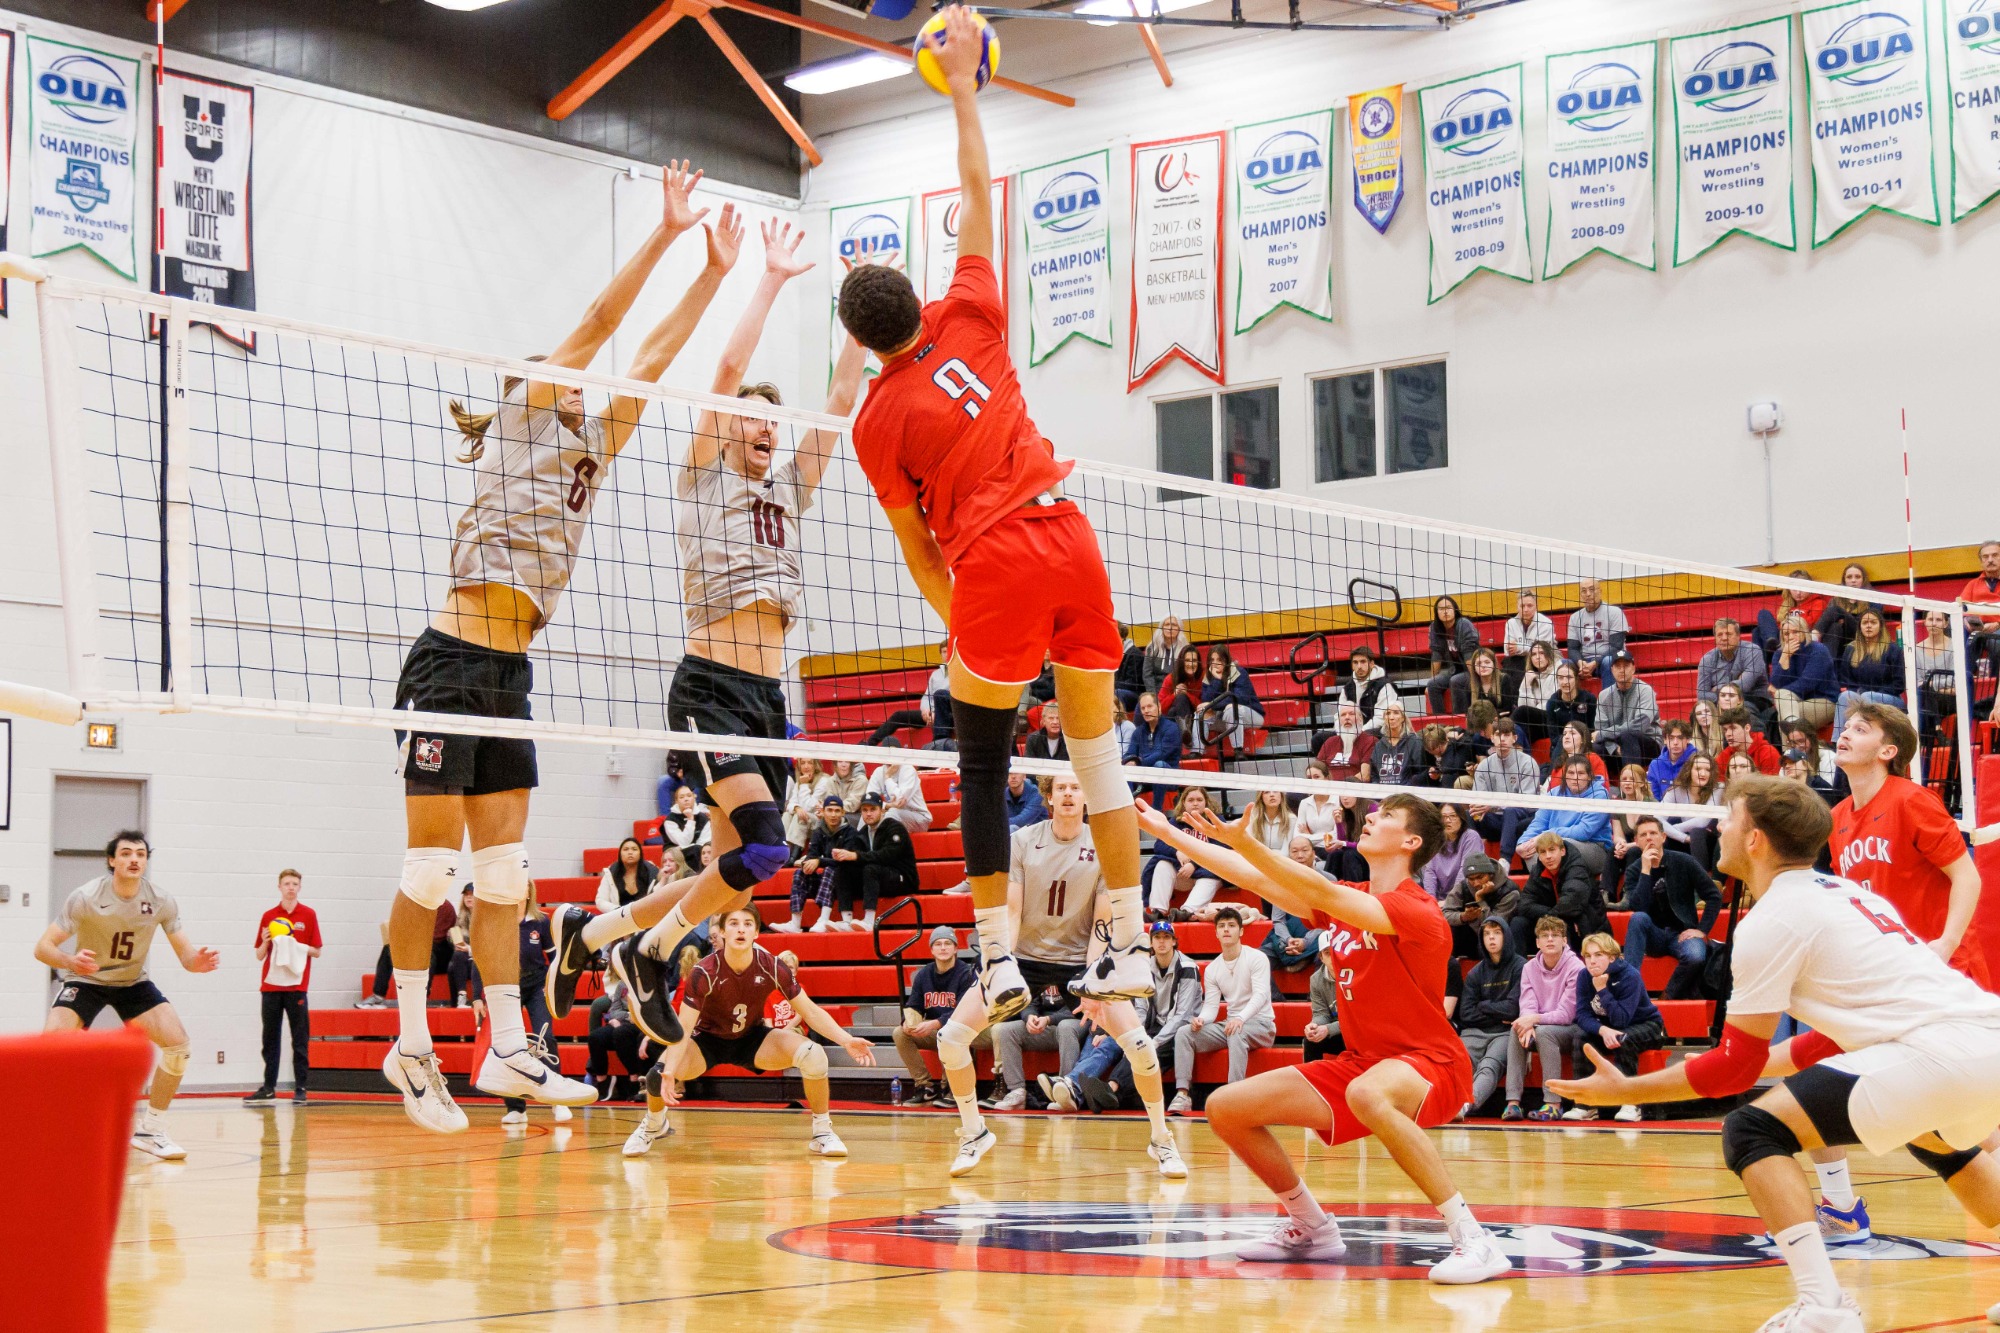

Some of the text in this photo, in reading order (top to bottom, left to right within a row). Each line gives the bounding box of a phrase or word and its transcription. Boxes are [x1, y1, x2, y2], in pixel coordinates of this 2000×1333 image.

[1818, 32, 1914, 72] OUA
[1684, 62, 1777, 97] OUA
[38, 72, 127, 110] OUA
[1557, 84, 1642, 114] OUA
[1955, 86, 2000, 108] CHA
[184, 121, 224, 140] SPORTS
[1432, 107, 1513, 143] OUA
[1816, 102, 1923, 139] CHAMPIONS
[40, 134, 130, 166] CHAMPIONS
[1684, 130, 1785, 162] CHAMPIONS
[1840, 136, 1898, 154] Women's
[1246, 150, 1322, 180] OUA
[1549, 151, 1648, 178] CHAMPIONS
[1704, 162, 1760, 178] Women's
[1838, 150, 1902, 169] Wrestling
[193, 166, 214, 184] MEN'S
[1702, 176, 1764, 192] Wrestling
[174, 180, 234, 216] WRESTLING
[1430, 170, 1520, 206] CHAMPIONS
[1580, 184, 1615, 194] Men's
[1842, 178, 1902, 200] 2010-11
[1034, 189, 1100, 220] OUA
[1452, 202, 1502, 220] Women's
[1571, 197, 1625, 210] Wrestling
[1705, 204, 1764, 222] 2009-10
[34, 206, 128, 233] Men's Wrestling
[188, 212, 219, 241] LUTTE
[1242, 210, 1326, 240] CHAMPIONS
[1452, 216, 1504, 234] Wrestling
[64, 226, 103, 241] 2019-20
[1571, 224, 1626, 240] 2008-09
[186, 239, 222, 262] MASCULINE
[840, 234, 901, 256] OUA
[1150, 236, 1202, 252] CHAMPIONS
[1268, 242, 1298, 253] Men's
[1454, 241, 1505, 262] 2008-09
[1268, 254, 1299, 267] Rugby
[1050, 274, 1092, 289] Women's
[1146, 268, 1207, 286] BASKETBALL
[1269, 280, 1298, 294] 2007
[1049, 286, 1094, 302] Wrestling
[1170, 290, 1206, 304] HOMMES
[1052, 310, 1094, 327] 2007-08
[932, 358, 992, 420] 9
[566, 457, 598, 513] 6
[752, 500, 784, 549] 10
[1839, 836, 1892, 878] BROCK
[1047, 880, 1066, 917] 11
[110, 932, 134, 961] 15
[1339, 968, 1354, 1000] 2
[732, 1004, 747, 1033] 3
